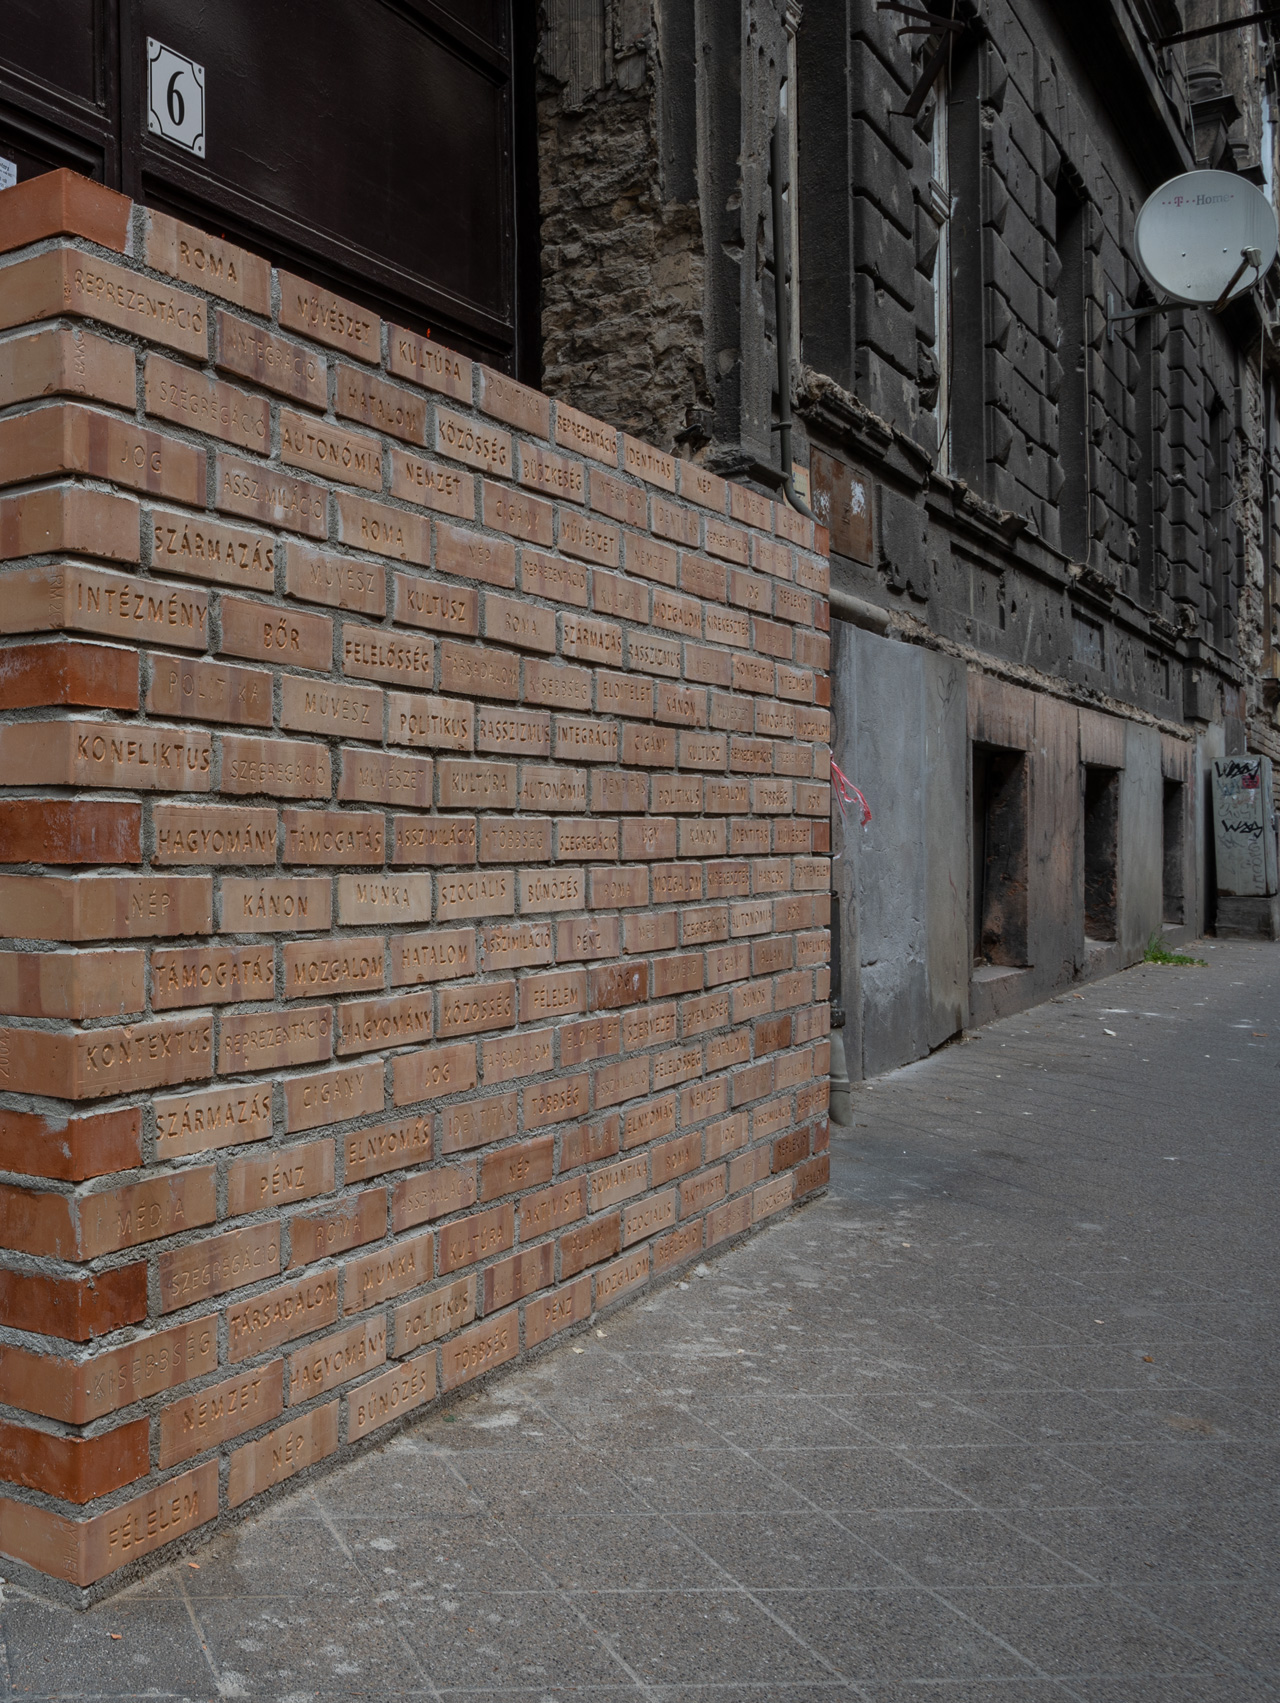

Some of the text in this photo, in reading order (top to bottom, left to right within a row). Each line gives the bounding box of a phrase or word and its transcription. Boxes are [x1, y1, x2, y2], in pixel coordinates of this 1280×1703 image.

[166, 70, 186, 126] 6
[1196, 194, 1229, 206] Home
[180, 240, 237, 283] ROMA
[74, 269, 203, 332] REPREZENTÁCIÓ
[233, 332, 315, 382] INTEGRÁCIÓ
[399, 340, 461, 380] KULTÚRA
[159, 380, 266, 438] SZEGREGÁCIÓ
[348, 386, 416, 430] HATALOM
[120, 444, 163, 474] JOG
[282, 428, 381, 475] AUTONÓMIA
[438, 420, 506, 464] KÖZÖSSÉG
[406, 462, 460, 497] NEMZET
[626, 446, 670, 478] IDENTITÁS
[223, 469, 322, 518] ASSZIMILÁCIÓ
[360, 516, 403, 546] ROMA
[496, 499, 539, 530] CIGÁNY
[154, 525, 274, 573] SZÁRMAZÁS
[76, 584, 208, 627] INTÉZMÉNY
[407, 589, 465, 622] KULTUSZ
[505, 612, 536, 634] ROMA
[263, 622, 299, 651] BŐR
[345, 640, 429, 672] FELELŐSSÉG
[169, 671, 260, 702] POLITIKA
[400, 713, 467, 737] POLITIKUS
[479, 719, 550, 743] RASSZIZMUS
[557, 725, 617, 747] INTEGRÁCIÓ
[77, 735, 209, 771] KONFLIKTUS
[230, 759, 325, 786] SZEGREGÁCIÓ
[451, 766, 507, 793] KULTÚRA
[522, 779, 585, 800] AUTONÓMIA
[158, 827, 277, 853] HAGYOMÁNY
[290, 828, 381, 853] TÁMOGATÁS
[396, 822, 475, 846] ASSZIMILÁCIÓ
[131, 889, 171, 917] NÉP
[243, 887, 307, 917] KÁNON
[356, 883, 410, 906] MUNKA
[441, 875, 505, 905] SZOCIÁLIS
[293, 955, 383, 987] MOZGALOM
[401, 944, 467, 970] HATALOM
[155, 955, 274, 996] TÁMOGATÁS
[534, 984, 577, 1011] FÉLELEM
[224, 1013, 328, 1055] REPREZENTÁCIÓ
[341, 1009, 431, 1044] HAGYOMÁNY
[86, 1027, 211, 1071] KONTEXTUS
[303, 1074, 364, 1109] CIGÁNY
[425, 1062, 449, 1087] JOG
[154, 1093, 270, 1142] SZÁRMAZÁS
[449, 1101, 513, 1136] IDENTITÁS
[348, 1121, 428, 1164] ELNYOMÁS
[260, 1165, 304, 1199] PÉNZ
[509, 1156, 529, 1183] NÉP
[590, 1160, 647, 1197] ROMANTIKA
[116, 1202, 184, 1237] MÉDIA
[525, 1188, 581, 1227] AKTIVISTA
[627, 1201, 671, 1236] SZOCIÁLIS
[316, 1220, 360, 1247] ROMA
[450, 1224, 503, 1263] KULTÚRA
[171, 1242, 279, 1297] SZEGREGÁCIÓ
[363, 1252, 415, 1291] MUNKA
[596, 1257, 648, 1299] MOZGALOM
[230, 1280, 337, 1342] TÁRSADALOM
[405, 1290, 468, 1339] POLITIKUS
[545, 1296, 572, 1327] PÉNZ
[93, 1330, 210, 1402] KISEBBSÉG
[289, 1332, 386, 1394] HAGYOMÁNY
[453, 1327, 507, 1375] TÖBBSÉG
[182, 1379, 260, 1435] NEMZET
[272, 1434, 304, 1472] NÉP
[107, 1491, 199, 1559] FÉLELEM
